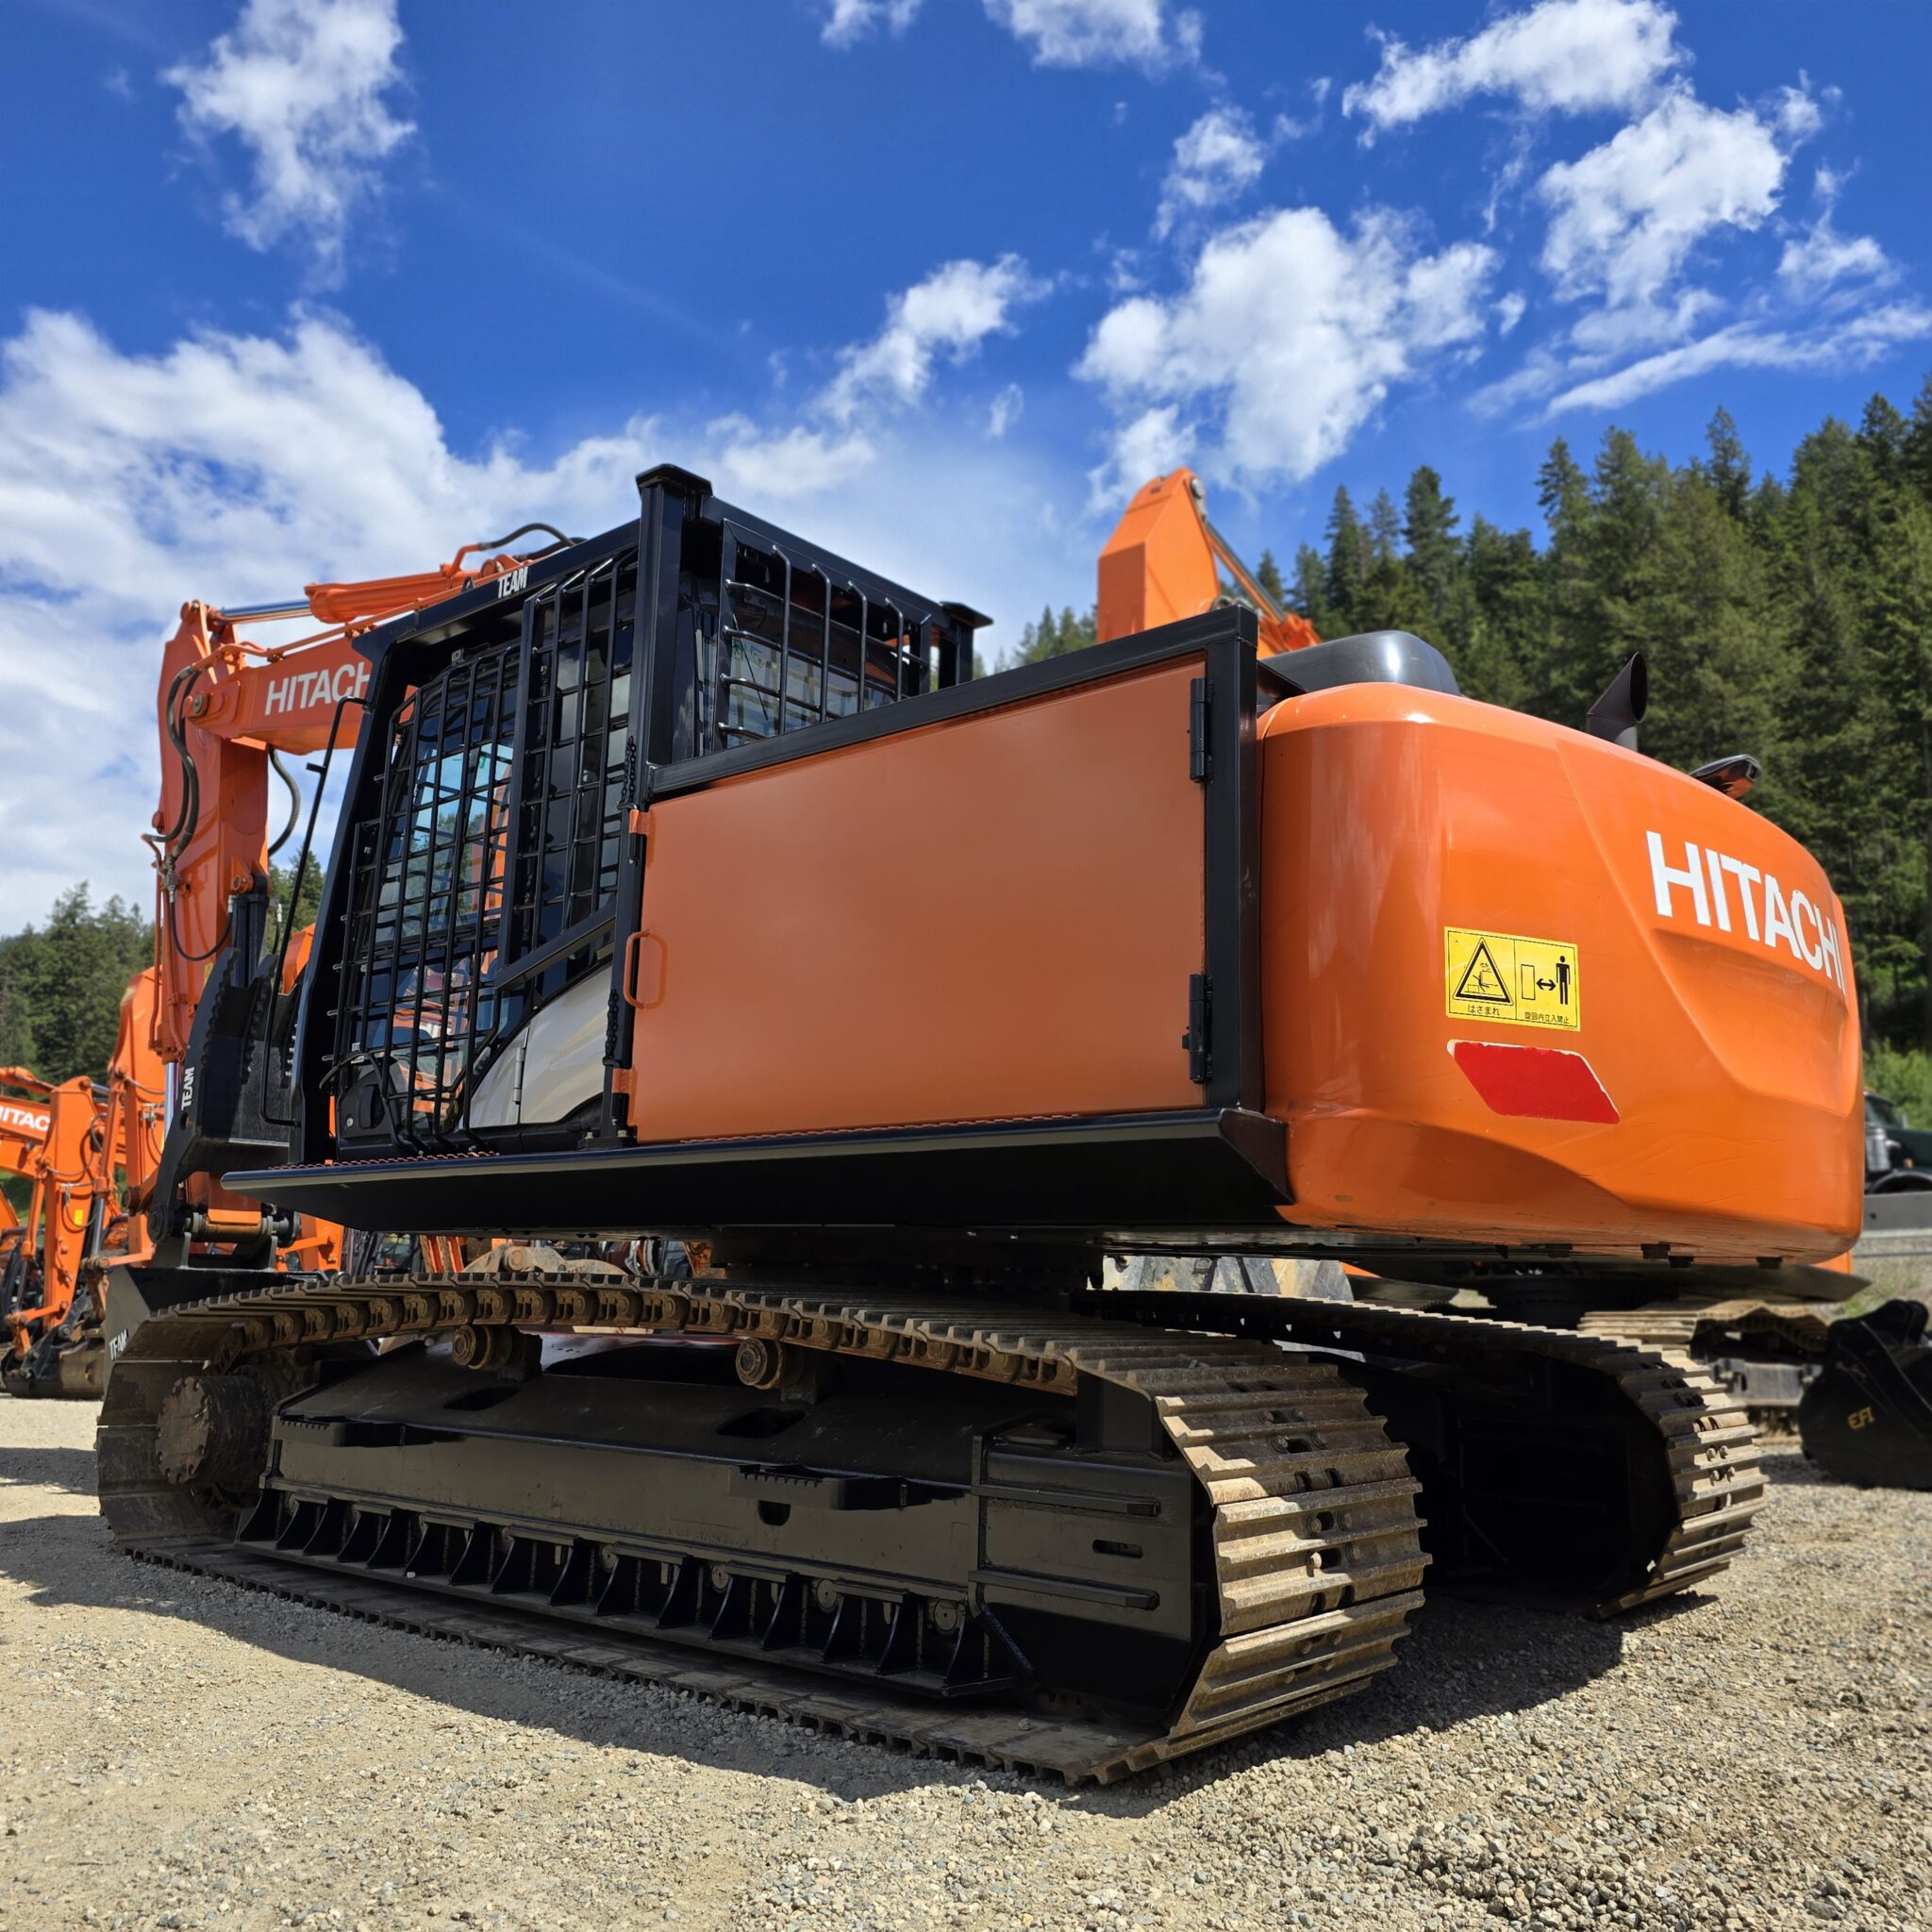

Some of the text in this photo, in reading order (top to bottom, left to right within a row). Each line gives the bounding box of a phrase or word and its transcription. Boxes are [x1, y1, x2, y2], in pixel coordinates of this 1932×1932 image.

[498, 566, 528, 598] TEAM
[1646, 830, 1846, 996] HITACHI
[1467, 1004, 1500, 1016] はさまれ
[181, 1066, 195, 1111] TEAM
